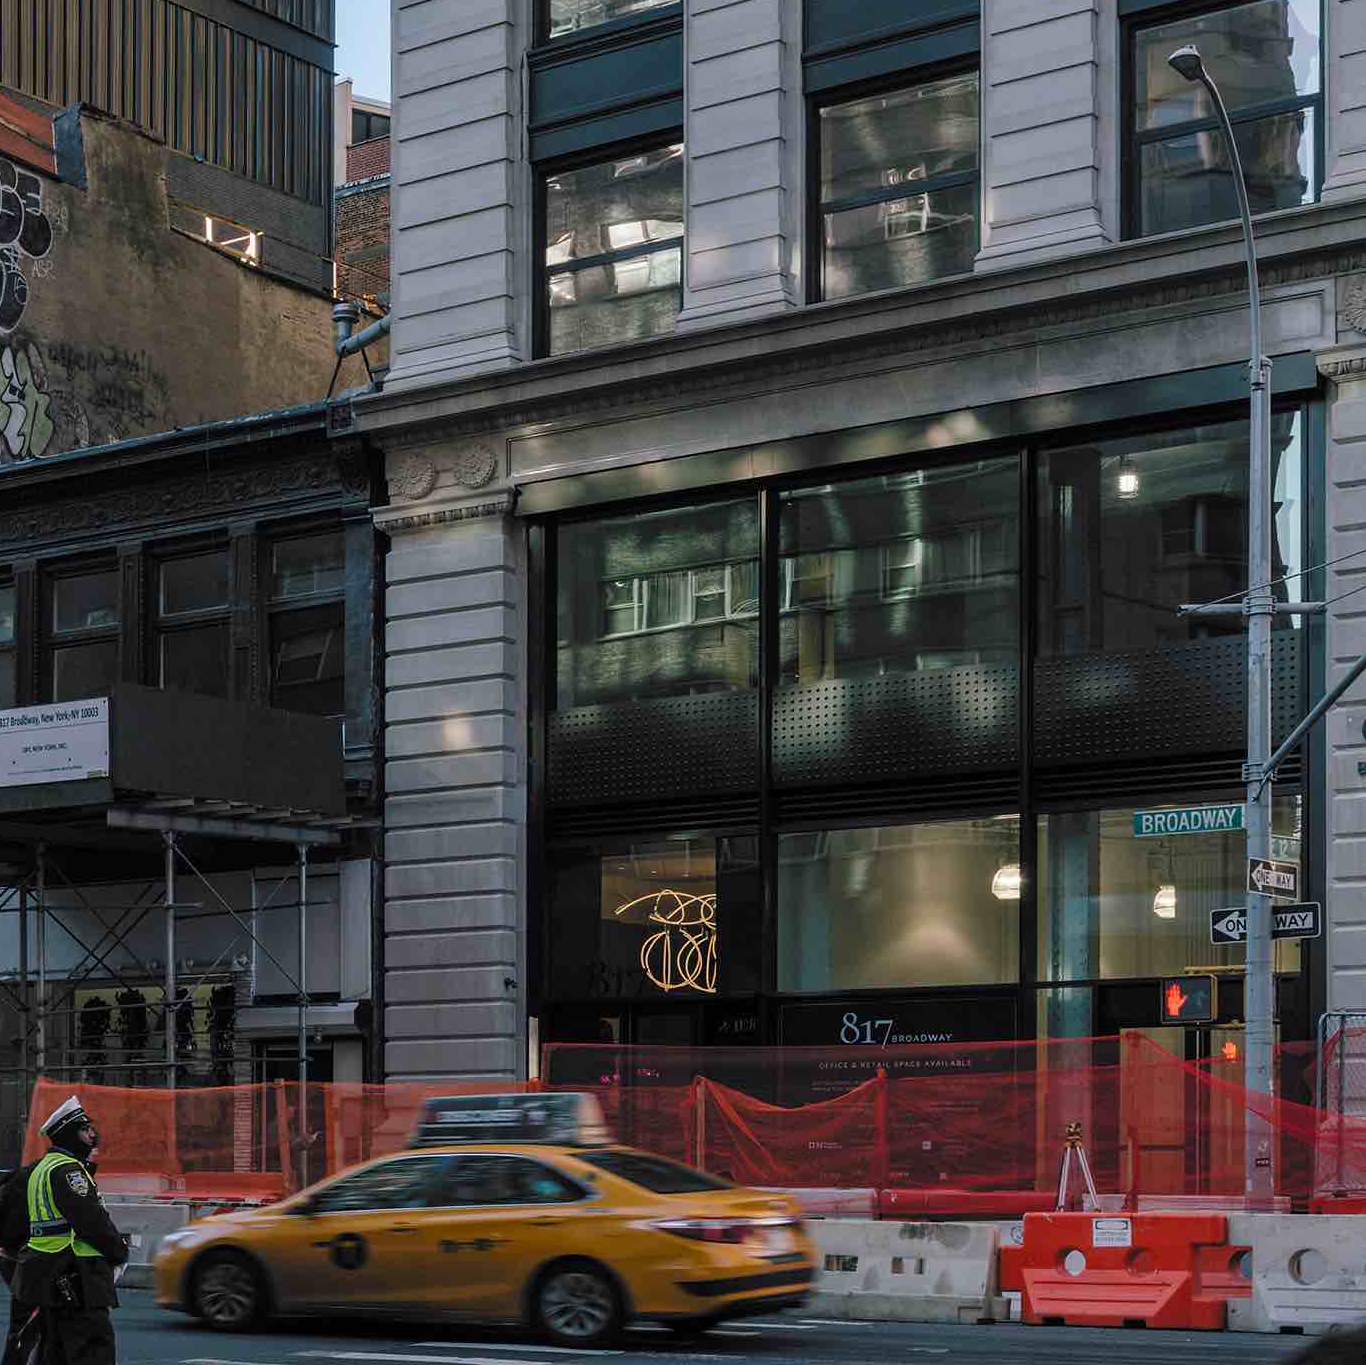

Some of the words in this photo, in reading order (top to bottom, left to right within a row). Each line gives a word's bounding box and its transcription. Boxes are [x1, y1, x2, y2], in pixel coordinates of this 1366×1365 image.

[81, 706, 99, 718] 10003
[1141, 808, 1236, 834] BROADWAY
[1256, 869, 1270, 885] ONE
[1275, 873, 1291, 887] WAY
[1225, 918, 1247, 933] ON
[1274, 914, 1309, 929] WAY
[840, 1012, 894, 1050] 817
[891, 1033, 954, 1043] BROADWAY
[818, 1061, 849, 1070] OFFICE
[860, 1060, 891, 1069] RETAIL
[893, 1060, 922, 1069] SPACE
[924, 1059, 972, 1069] AVAILABLE
